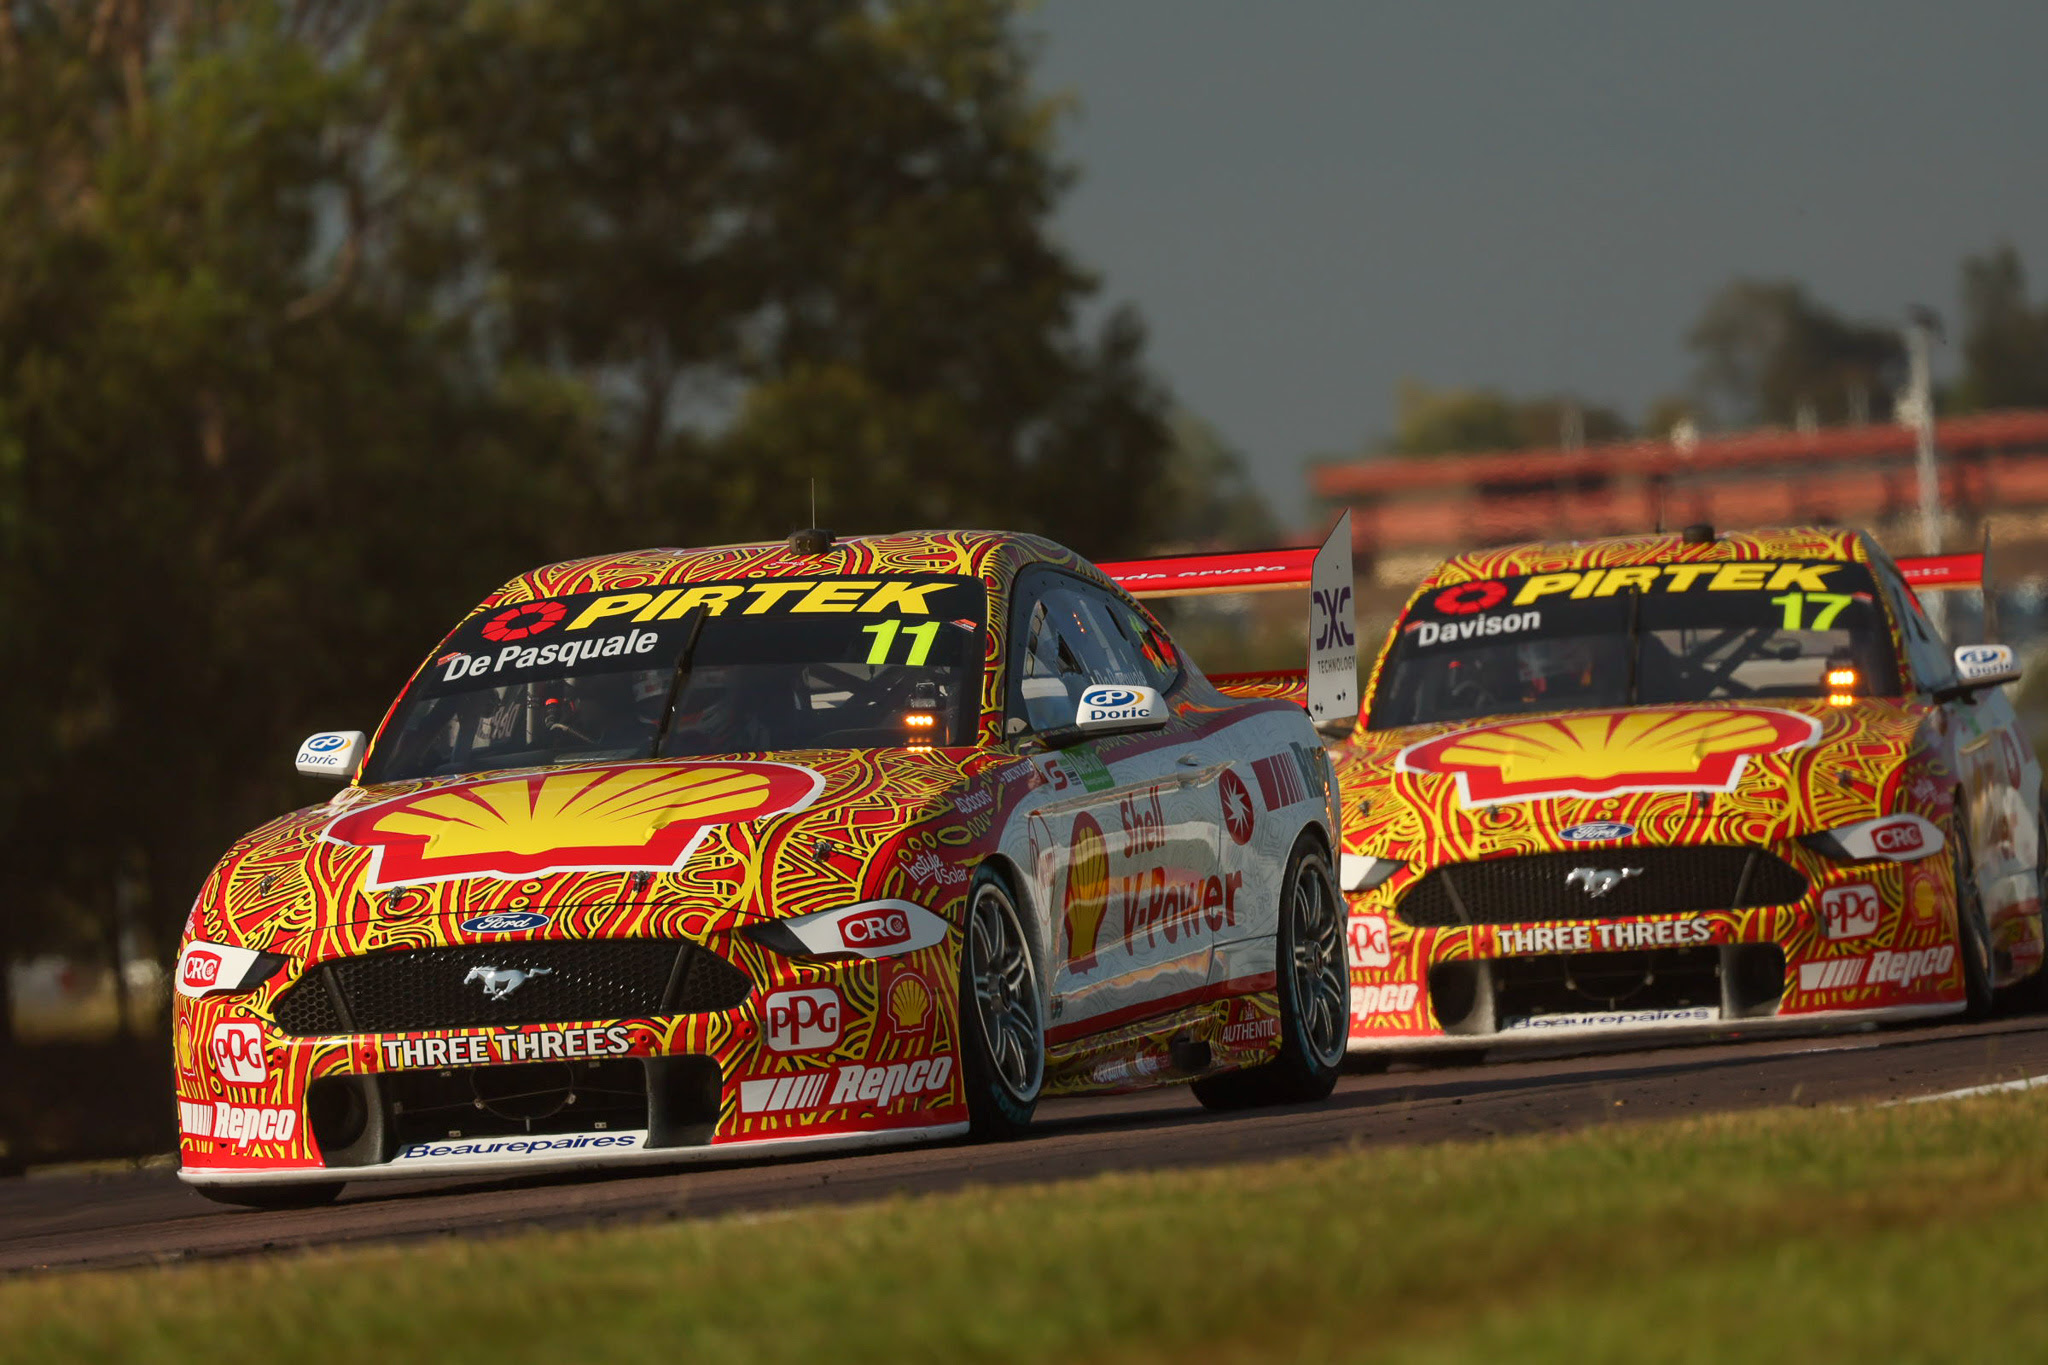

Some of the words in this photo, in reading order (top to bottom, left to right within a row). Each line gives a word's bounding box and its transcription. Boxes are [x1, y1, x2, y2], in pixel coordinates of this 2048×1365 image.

[1512, 563, 1843, 606] PIRTEK
[565, 581, 958, 631] PIRTEK
[1772, 592, 1852, 631] 17
[862, 619, 940, 666] 11
[1418, 611, 1541, 646] Davison
[443, 654, 490, 682] De
[494, 629, 659, 673] Pasquale
[1091, 707, 1150, 720] Doric
[298, 753, 338, 765] Doric
[1121, 787, 1165, 858] Shell
[1573, 823, 1619, 840] Ford
[1875, 822, 1923, 850] CRC
[941, 867, 968, 885] Solar
[475, 914, 532, 931] Ford
[844, 914, 908, 942] CRC
[1123, 867, 1242, 956] V-Power
[1827, 890, 1877, 935] PPG
[1499, 926, 1592, 953] THREE
[1596, 918, 1712, 947] THREES
[185, 957, 218, 980] CRC
[1866, 946, 1955, 988] Repco
[771, 996, 837, 1045] PPG
[1222, 1018, 1275, 1043] AUTHENTIC
[214, 1029, 264, 1080] PPG
[382, 1034, 491, 1068] THREE
[495, 1026, 630, 1061] THREES
[829, 1056, 953, 1108] Repco
[214, 1101, 297, 1149] Repco
[403, 1134, 637, 1160] Beaurepaires
